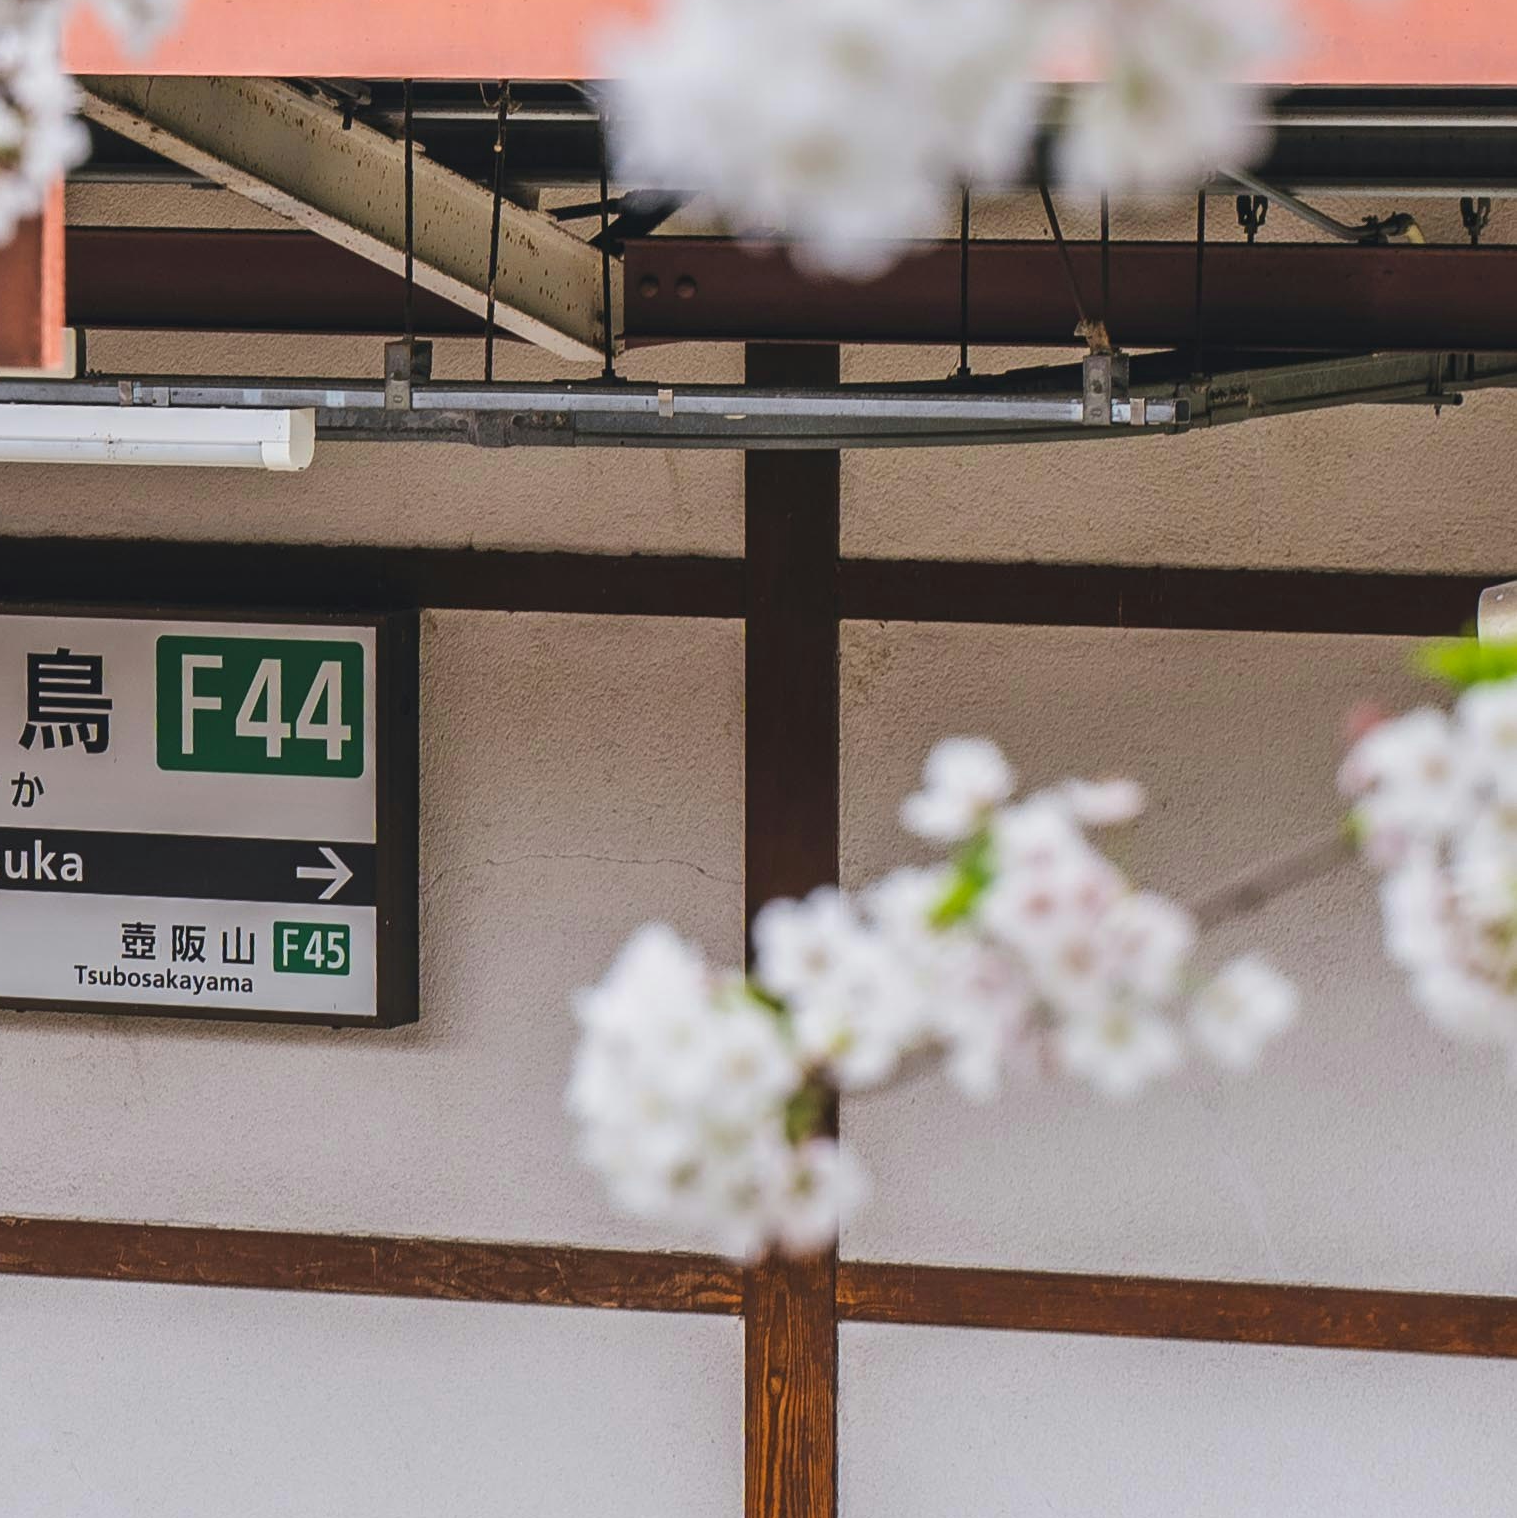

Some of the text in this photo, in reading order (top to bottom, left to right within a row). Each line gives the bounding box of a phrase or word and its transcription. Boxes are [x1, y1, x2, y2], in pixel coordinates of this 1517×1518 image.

[181, 653, 352, 761] F44
[281, 928, 346, 970] F45
[73, 964, 254, 995] Tsubosakayama
